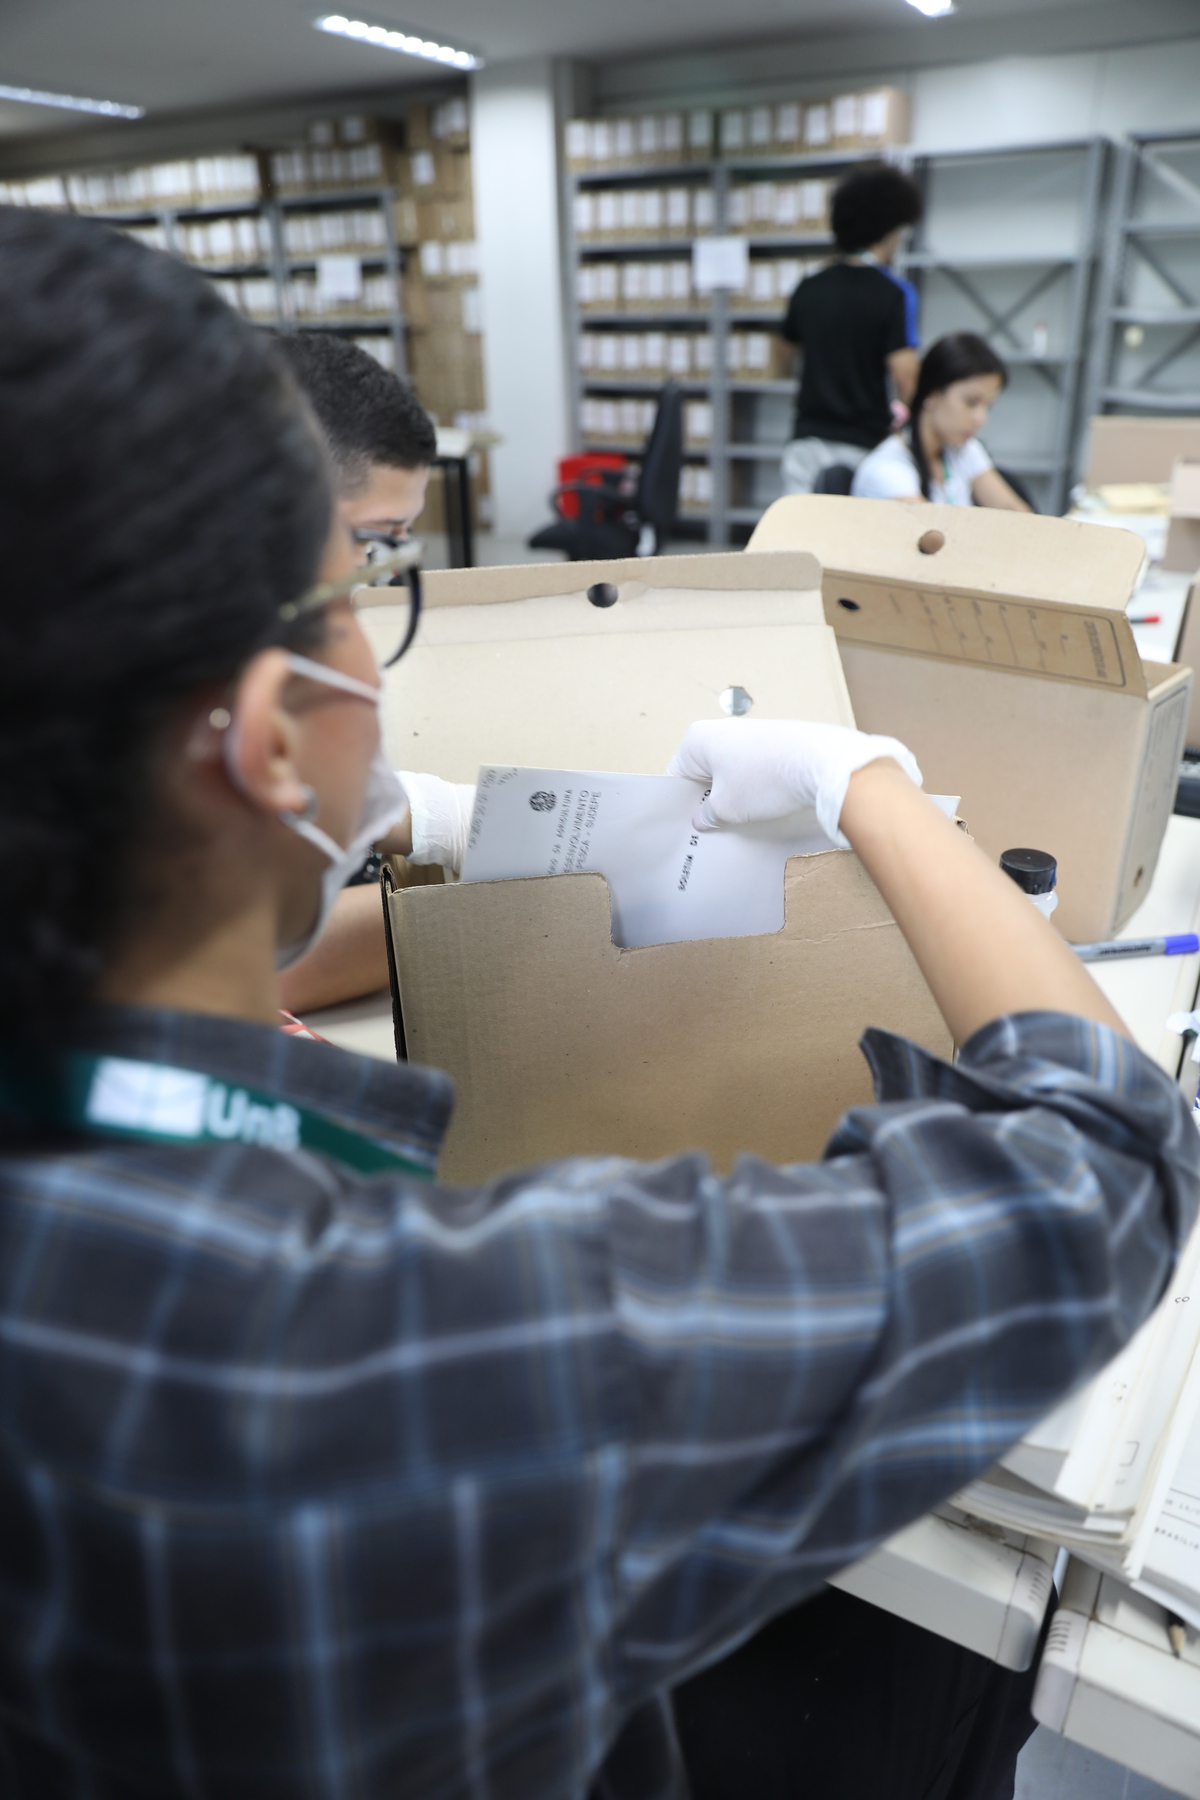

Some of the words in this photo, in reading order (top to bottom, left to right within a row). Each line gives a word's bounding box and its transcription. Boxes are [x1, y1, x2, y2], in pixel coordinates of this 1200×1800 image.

[556, 789, 573, 838] AGRICULTURA
[585, 791, 601, 828] SUDEPE
[563, 790, 590, 874] ESENVOLVIMENTO
[689, 834, 699, 846] DE
